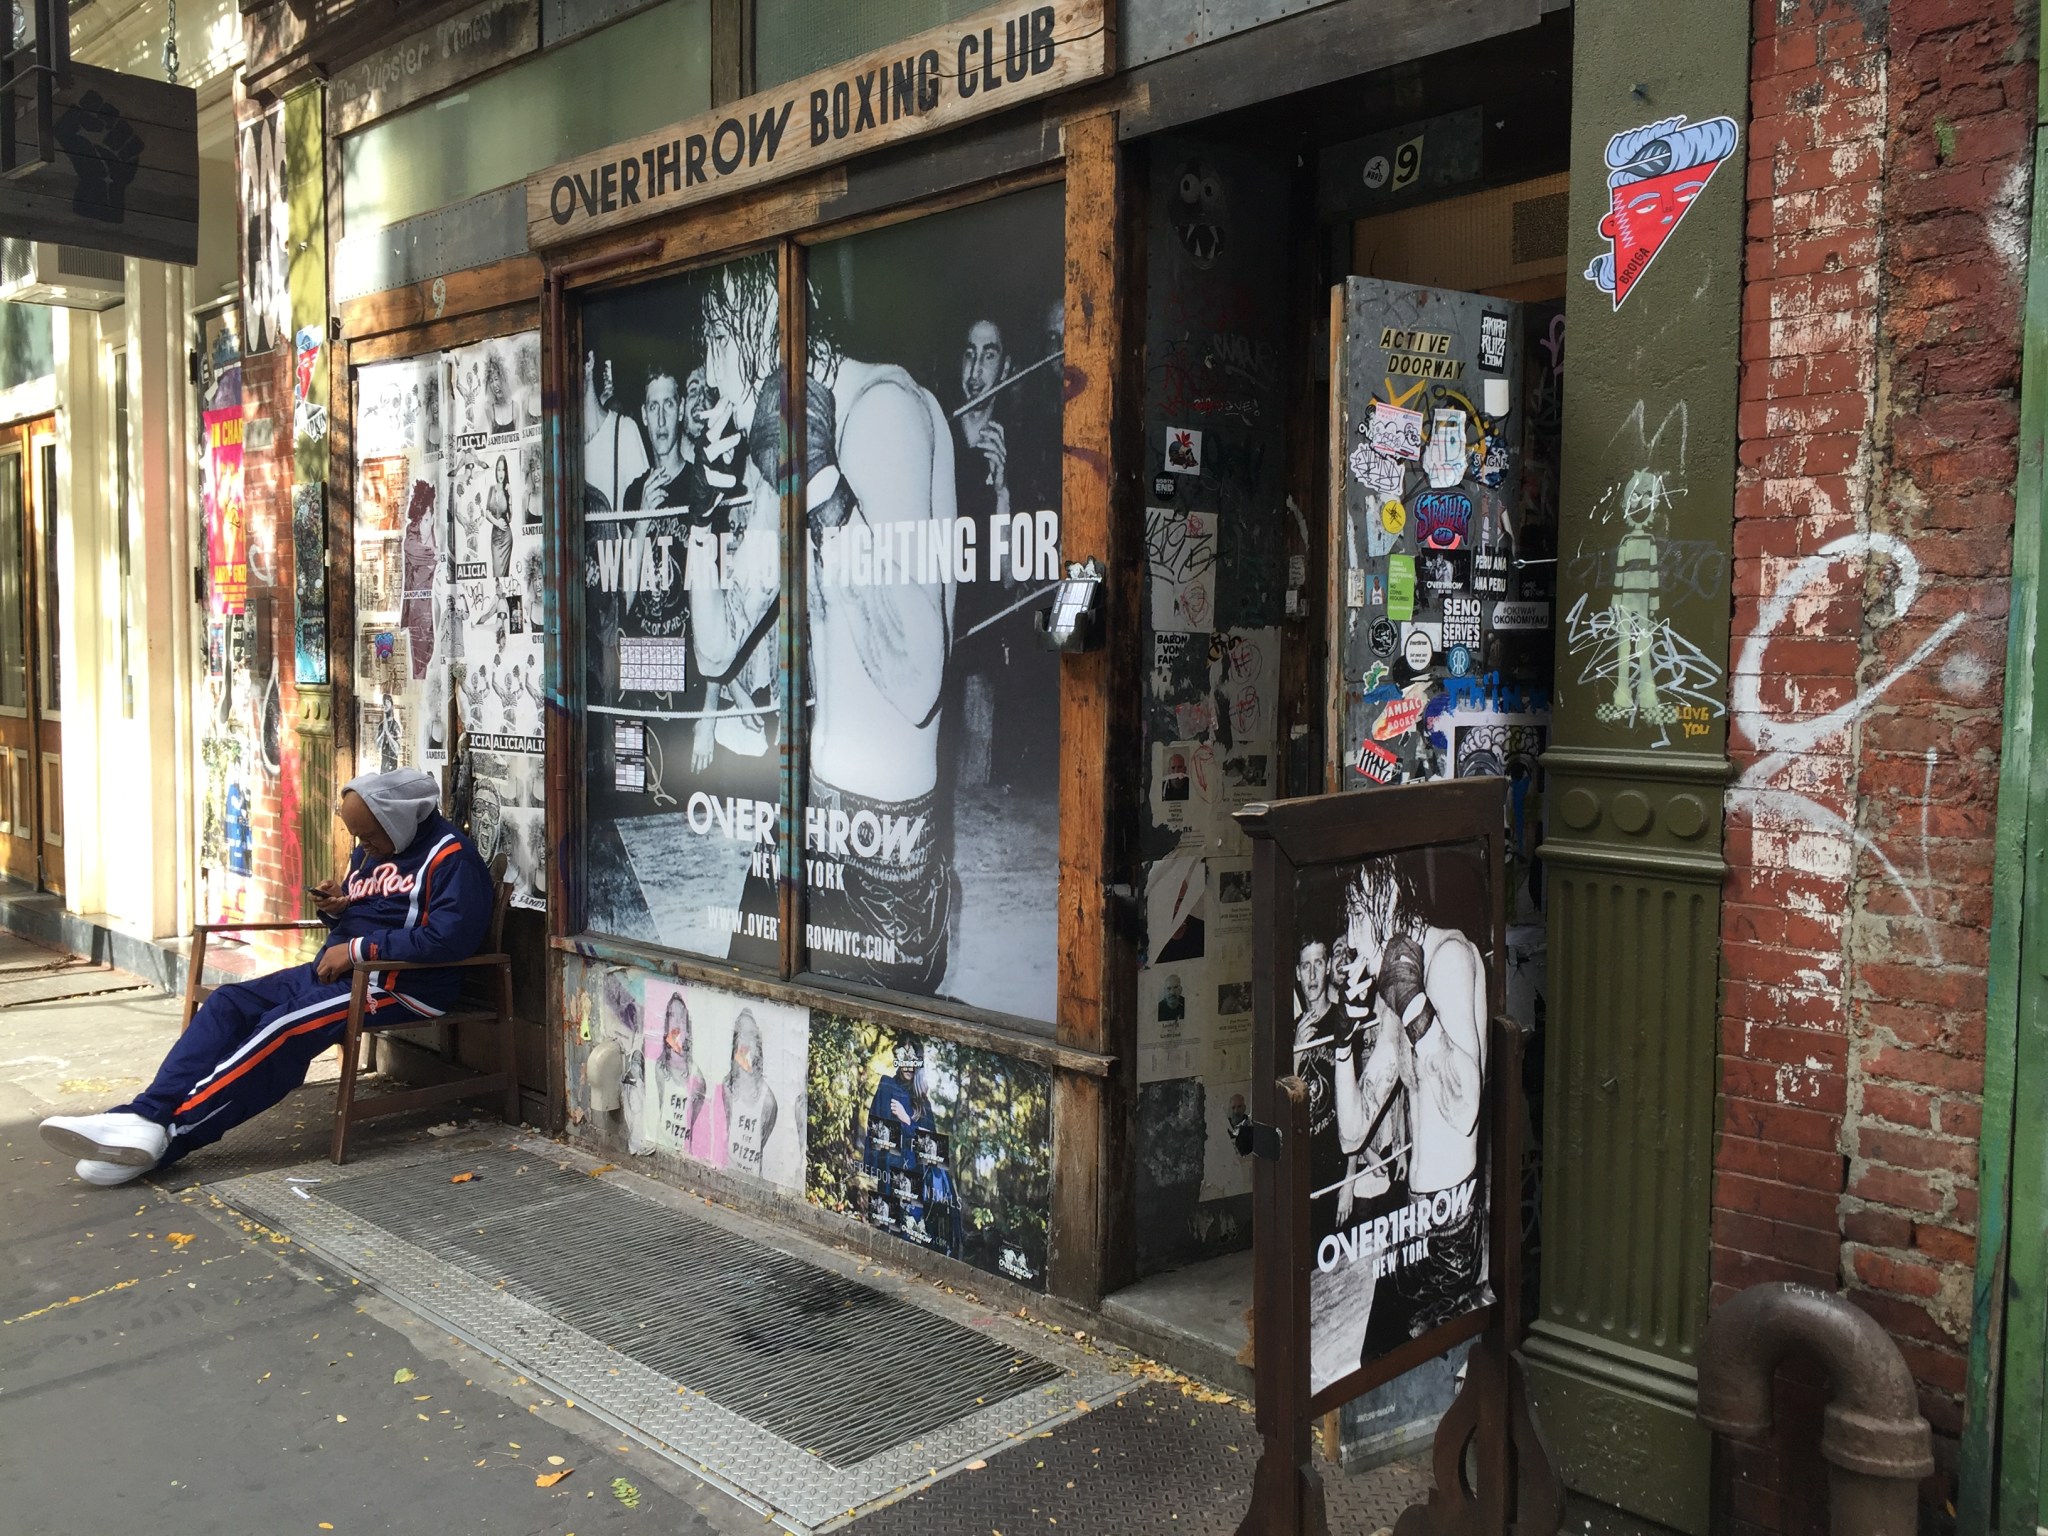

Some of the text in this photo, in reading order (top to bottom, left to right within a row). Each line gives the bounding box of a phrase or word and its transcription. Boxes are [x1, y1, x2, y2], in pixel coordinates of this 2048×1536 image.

[550, 6, 1055, 226] OVERTHROW BOXING CLUB
[1396, 144, 1419, 183] 9
[1619, 247, 1650, 285] BROLGA
[432, 277, 446, 319] 9
[1481, 316, 1507, 338] AKIRA
[1380, 329, 1449, 354] ACTIVE
[1481, 335, 1506, 356] RUIZ
[1387, 354, 1466, 379] DOORWAY
[597, 535, 673, 592] WHAT
[684, 531, 734, 591] ARE
[821, 515, 978, 588] FIGHTING
[989, 509, 1060, 582] FOR
[457, 564, 487, 577] ALICIA
[403, 590, 432, 598] SANDFLOWER
[1426, 580, 1463, 590] OVERTHROW
[1443, 598, 1481, 617] SENO
[1443, 616, 1481, 624] SMASHED
[1494, 615, 1548, 625] OKONOMIYAKI
[1157, 635, 1188, 644] BARON
[1443, 624, 1480, 641] SERVE'S
[1158, 655, 1175, 664] FAN
[1163, 645, 1180, 654] VON
[1676, 705, 1709, 720] LOVE
[1683, 722, 1710, 738] YOU
[470, 735, 491, 749] ICIA
[493, 735, 524, 751] ALICIA
[687, 791, 926, 863] OVERHROW
[806, 860, 845, 891] YORK
[708, 906, 896, 965] WWW.OVERROWNYC.COM
[670, 1094, 687, 1110] EAT
[665, 1120, 691, 1140] PIZZA
[738, 1115, 757, 1132] EAT
[732, 1142, 760, 1163] PIZZA
[853, 1160, 890, 1184] FREEDO
[924, 1185, 962, 1210] NIMALS
[1317, 1178, 1478, 1272] OVERTHROW
[1372, 1237, 1430, 1280] NEW YORK
